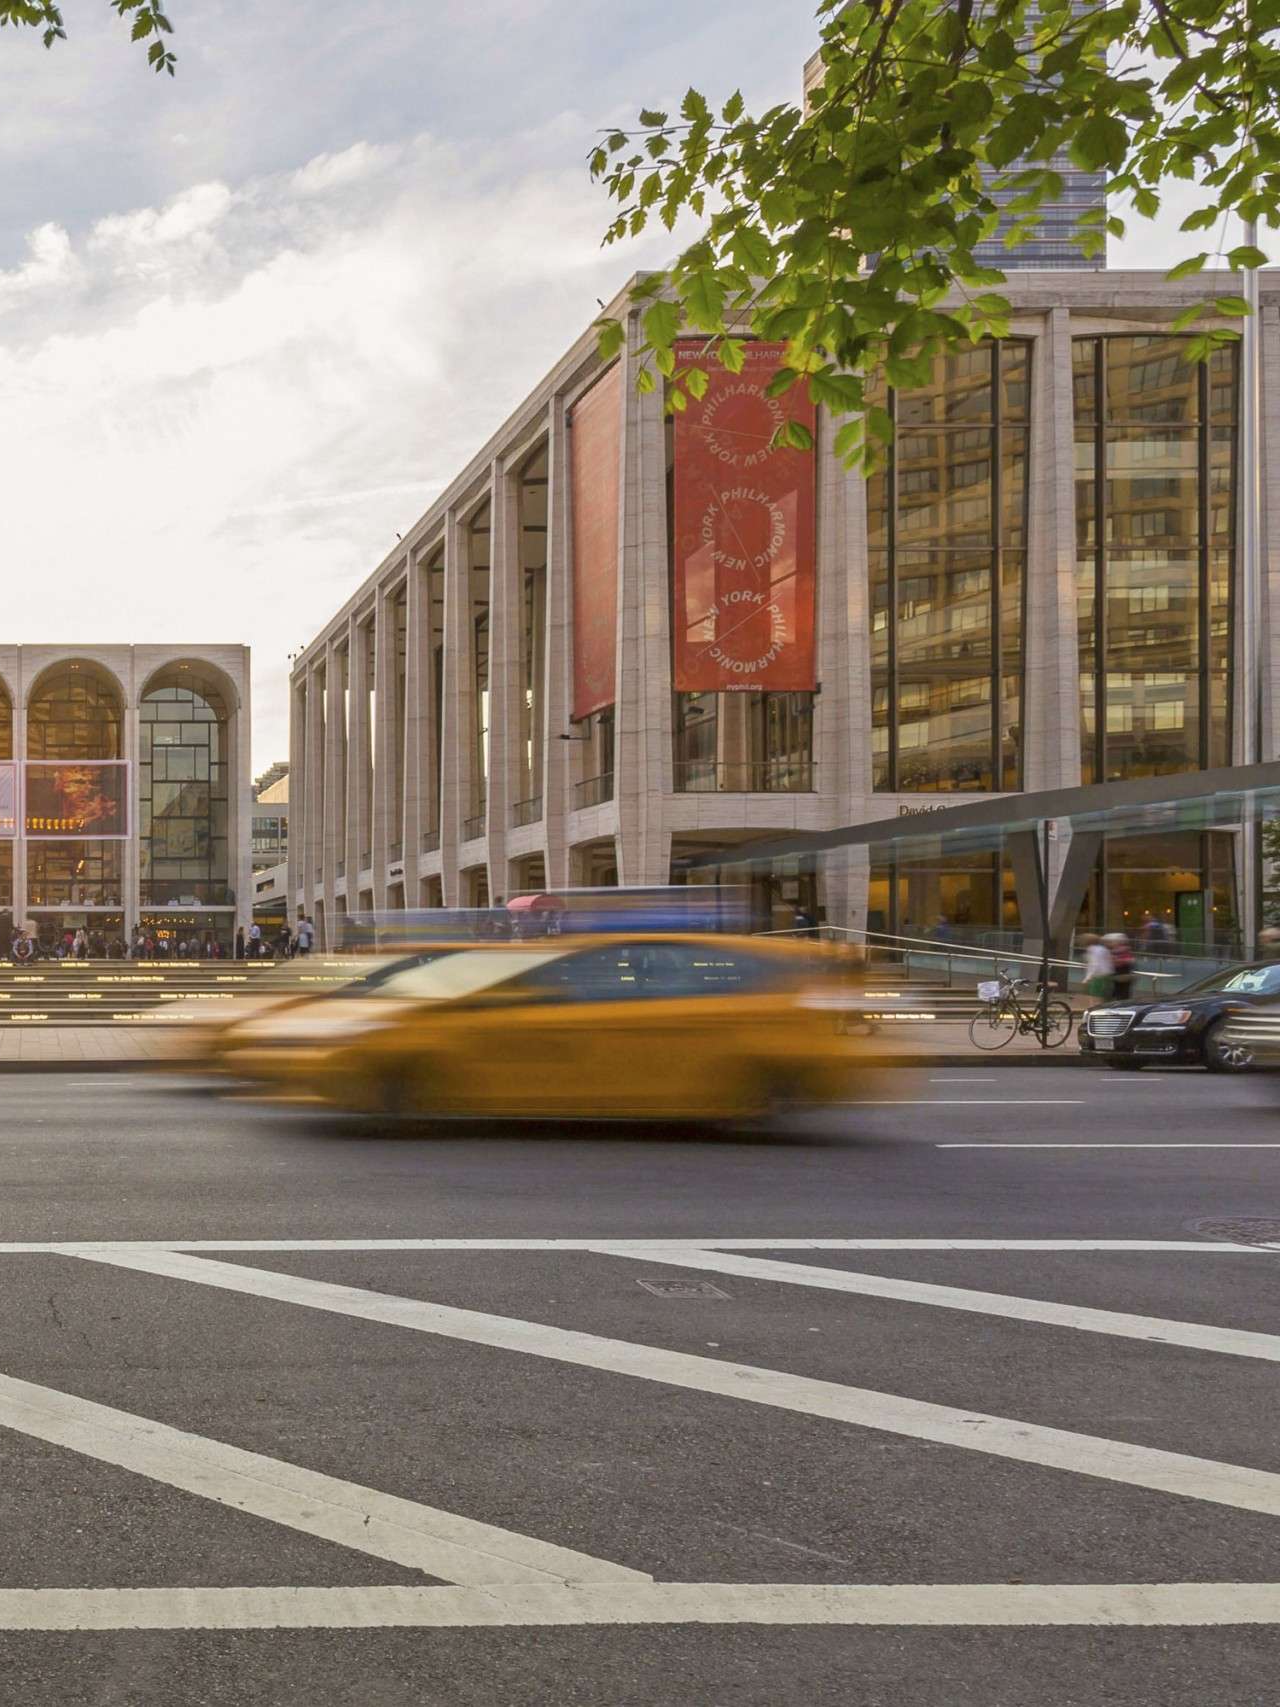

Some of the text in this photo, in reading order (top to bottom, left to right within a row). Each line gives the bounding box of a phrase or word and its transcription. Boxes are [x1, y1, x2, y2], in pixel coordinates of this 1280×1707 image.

[678, 351, 701, 360] NEW
[704, 432, 737, 466] YORK
[702, 487, 786, 571] NEW YORK PHILHARMONIC
[703, 590, 787, 674] NEW YORK PHILHARMONIC
